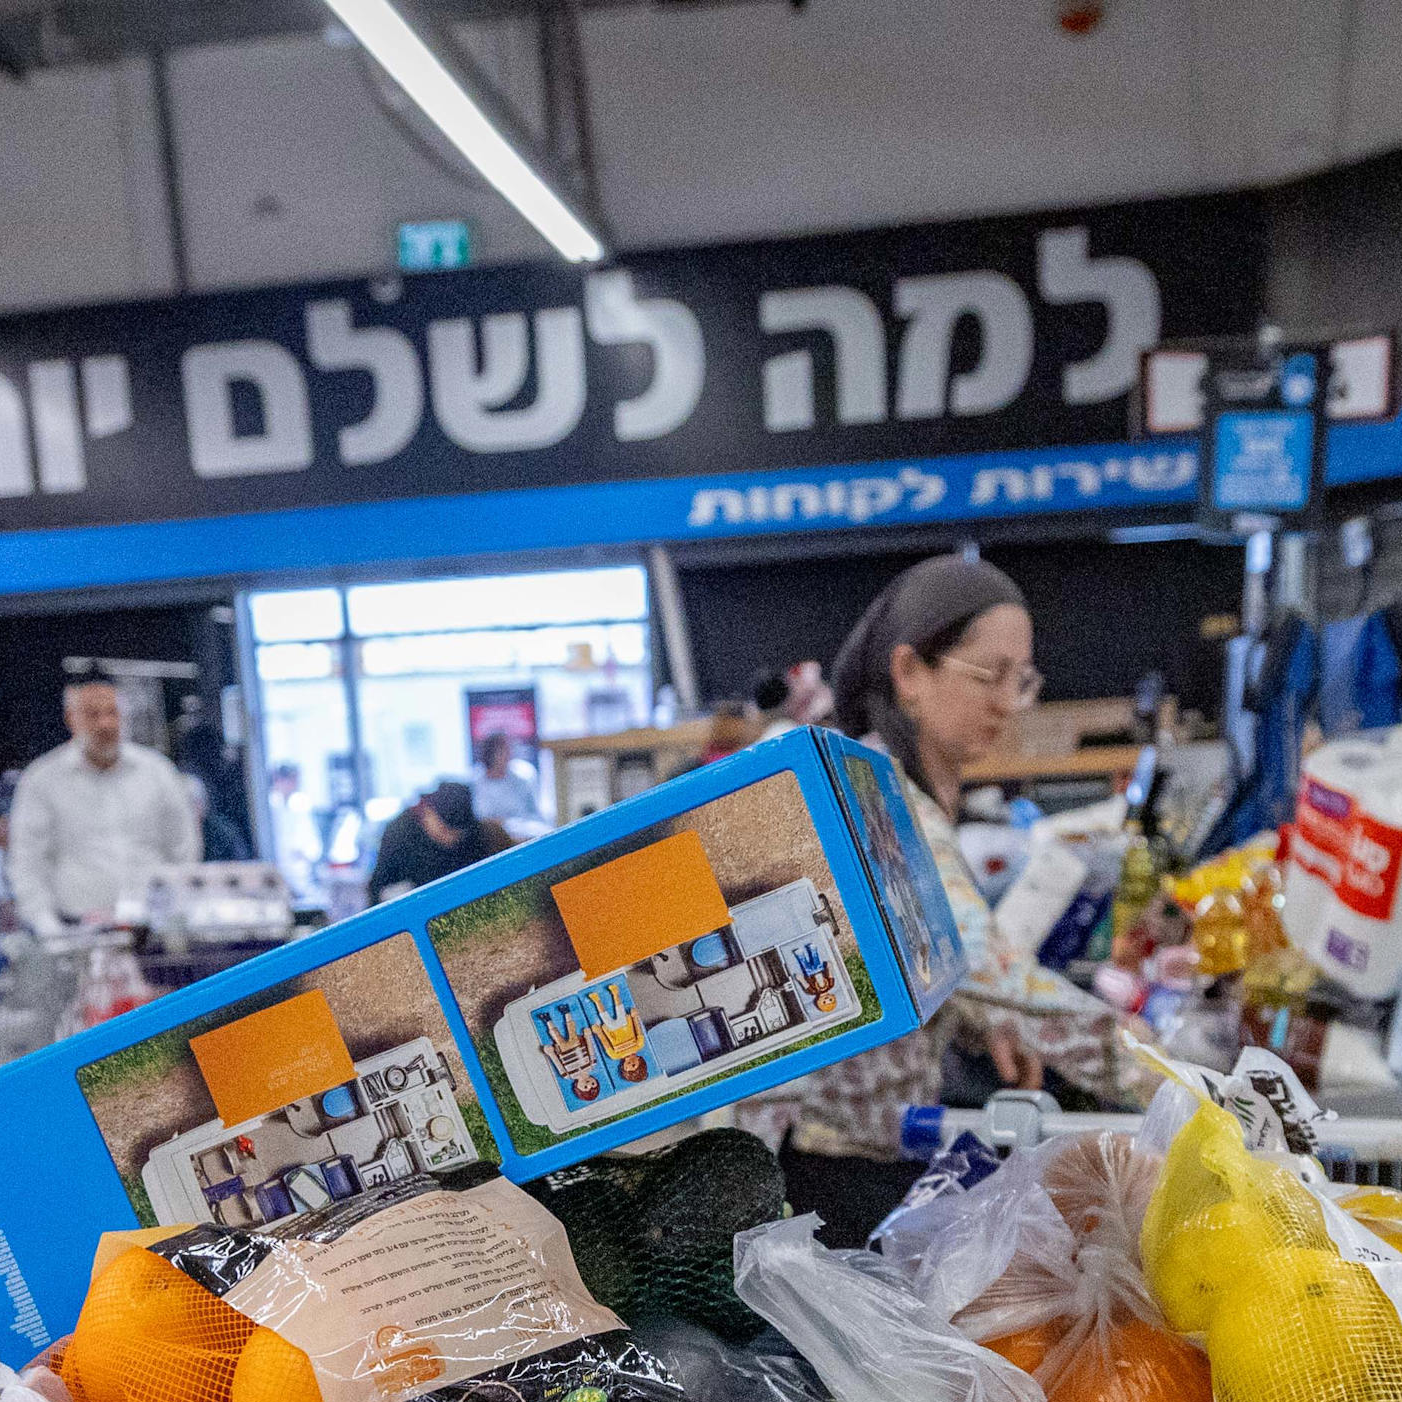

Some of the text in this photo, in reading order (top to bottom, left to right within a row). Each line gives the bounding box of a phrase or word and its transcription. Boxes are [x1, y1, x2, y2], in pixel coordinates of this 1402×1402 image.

[182, 268, 707, 479] לשלם
[760, 226, 1161, 433] למה
[688, 466, 947, 528] לקוחות
[971, 449, 1198, 507] שירות
